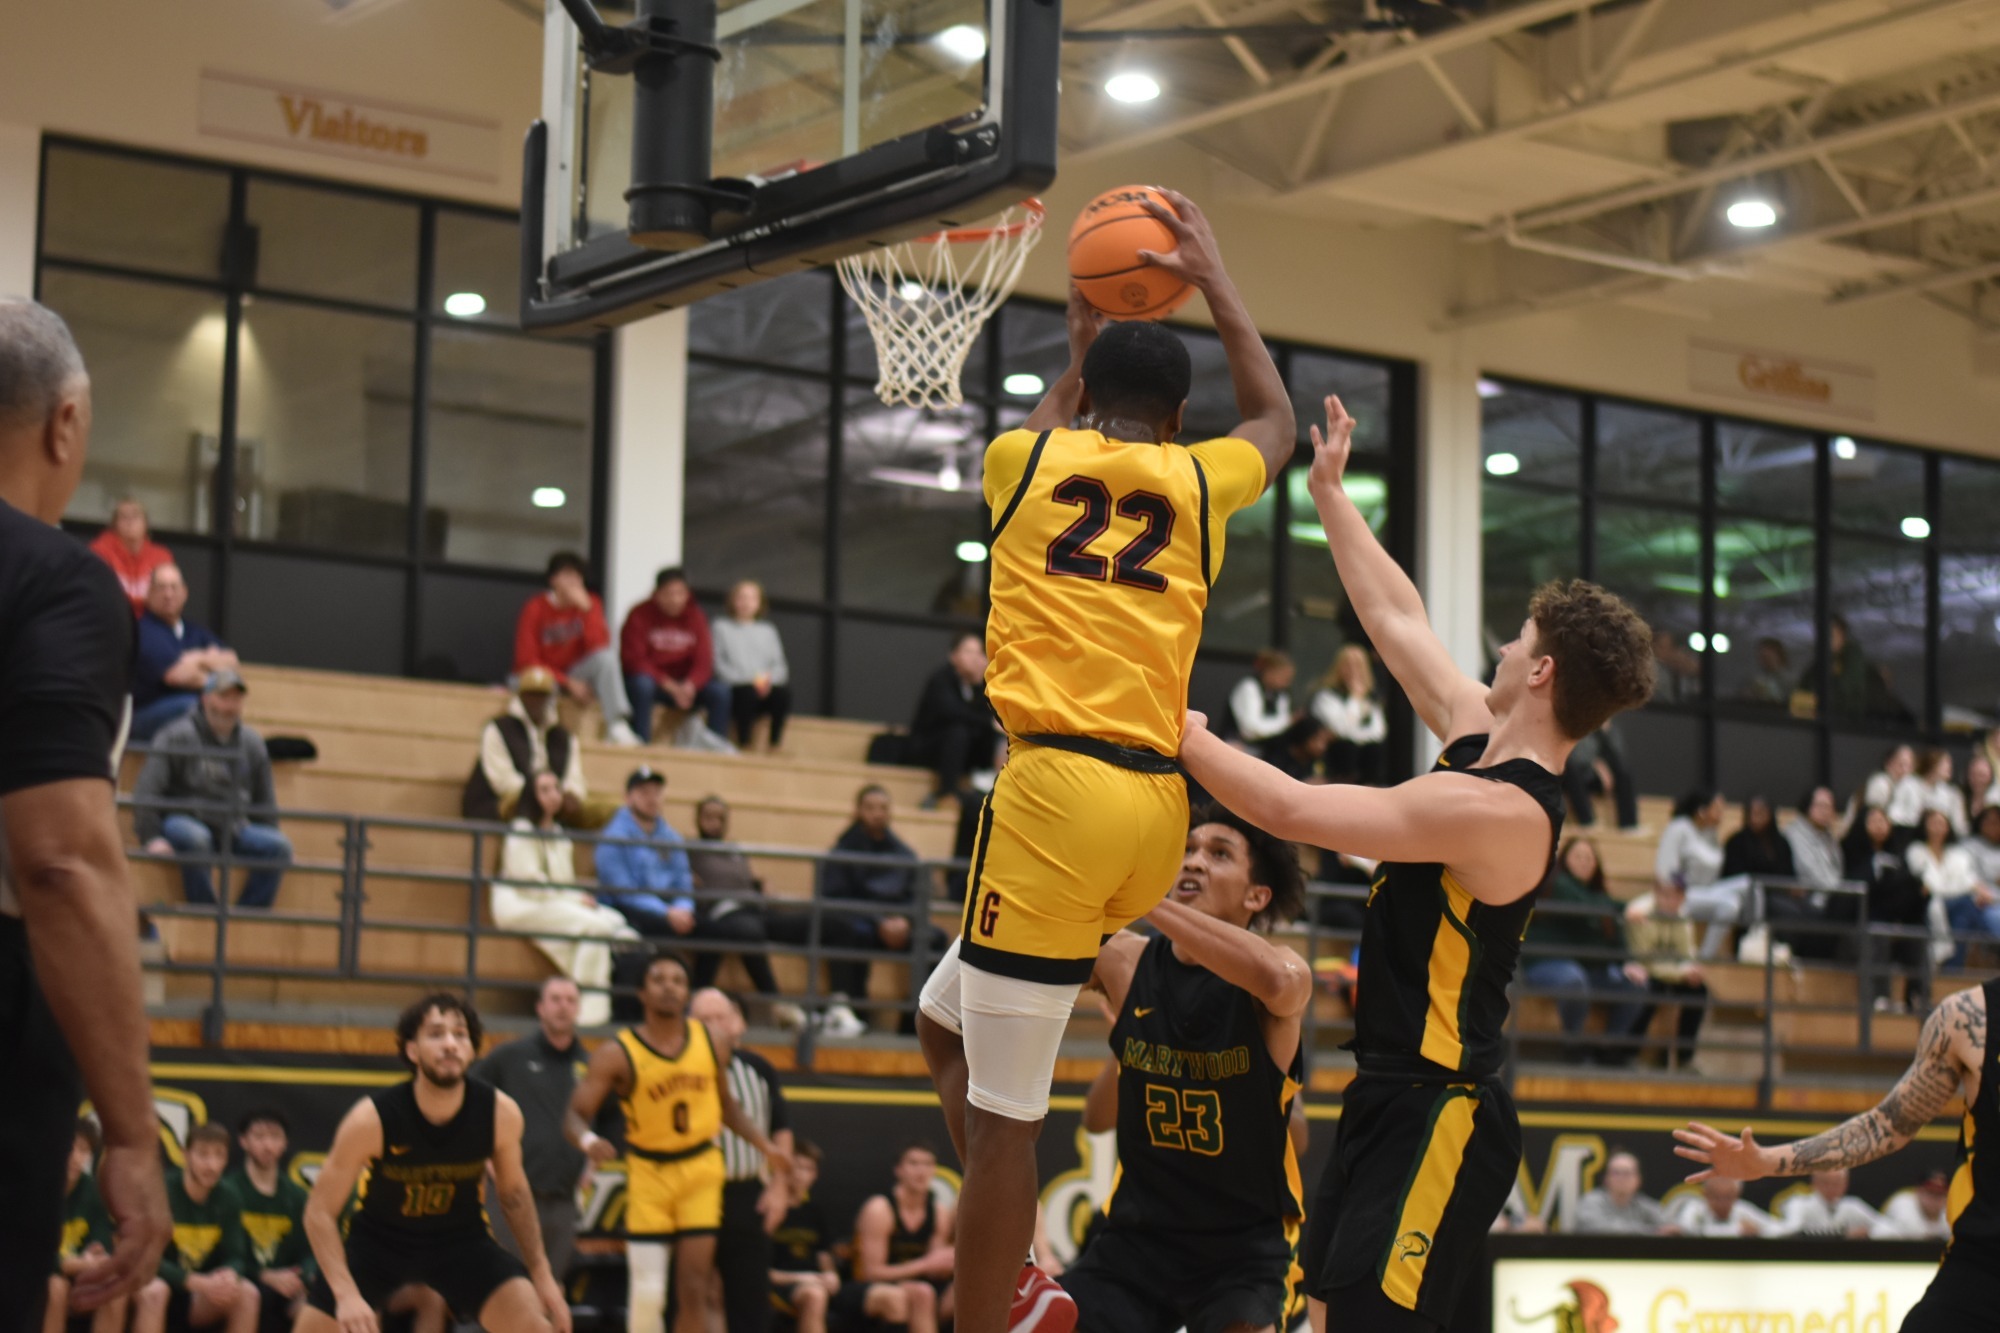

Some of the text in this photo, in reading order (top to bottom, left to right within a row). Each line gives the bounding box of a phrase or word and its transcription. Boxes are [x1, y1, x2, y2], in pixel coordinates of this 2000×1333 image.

[278, 96, 427, 157] Visitors
[1045, 474, 1176, 593] 22
[979, 890, 1001, 938] G
[1122, 1037, 1250, 1080] MARYWOOD
[1146, 1083, 1223, 1156] 23
